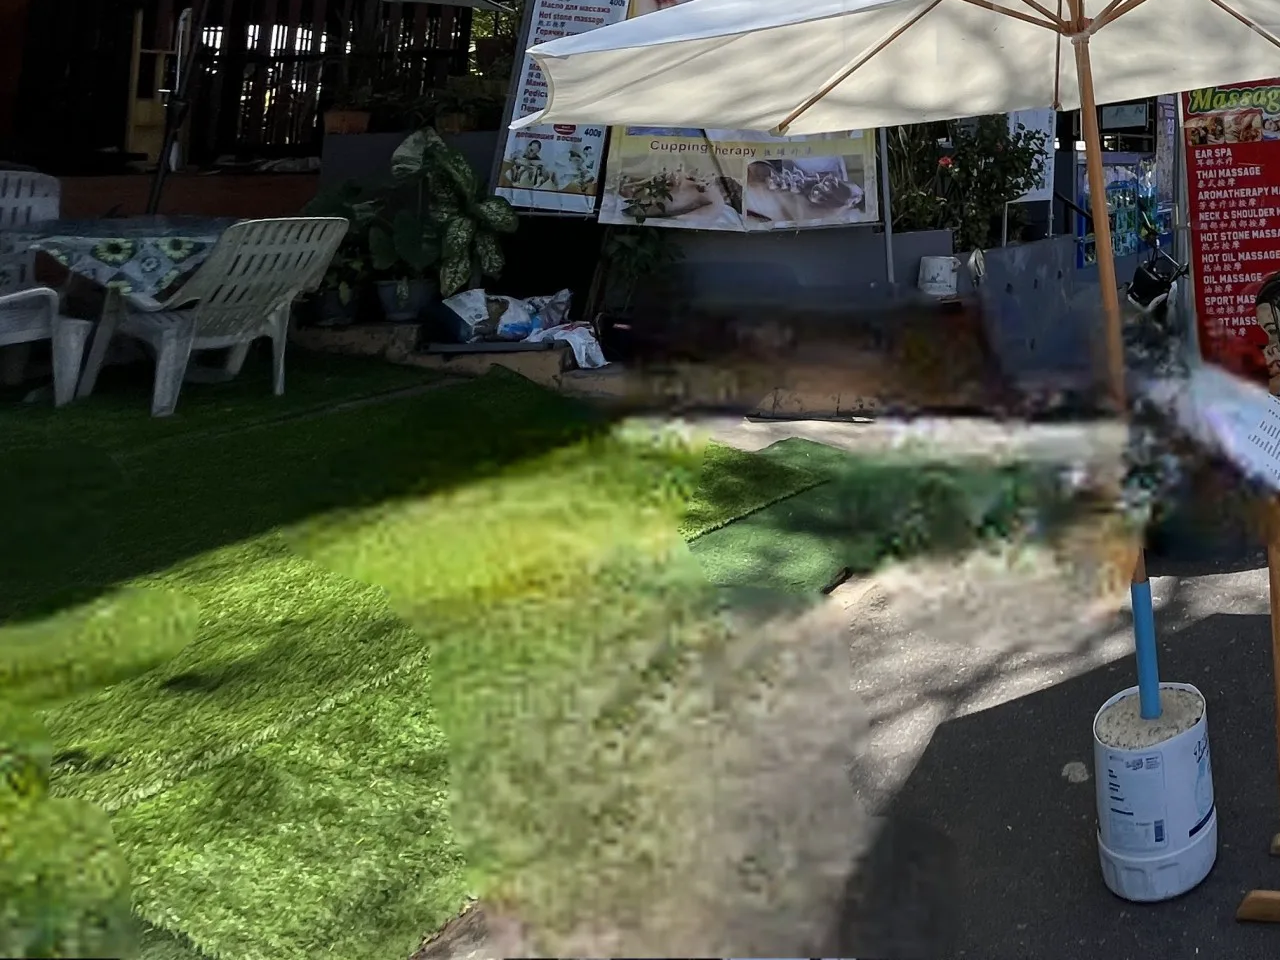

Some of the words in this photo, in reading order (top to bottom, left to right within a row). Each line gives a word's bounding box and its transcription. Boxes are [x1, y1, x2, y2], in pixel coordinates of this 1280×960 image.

[539, 11, 551, 19] Hot
[553, 13, 572, 21] stone
[574, 17, 604, 25] massage
[650, 140, 707, 154] Cupping
[1195, 149, 1213, 159] EAR
[1214, 148, 1232, 157] SPA
[1196, 169, 1217, 179] THAI
[1218, 167, 1261, 178] MASSAGE
[1198, 187, 1269, 200] AROMATHERAPY
[1199, 211, 1220, 221] NECK
[1223, 210, 1229, 219] &
[1231, 206, 1275, 219] SHOULDER
[1200, 233, 1218, 242] HOT
[1220, 230, 1250, 241] STONE
[1202, 254, 1220, 263] HOT
[1222, 252, 1236, 262] OIL
[1238, 250, 1280, 261] MASSAGE
[1203, 275, 1218, 285] OIL
[1220, 272, 1262, 283] MASSAGE
[1204, 295, 1235, 306] SPORT
[1231, 315, 1260, 326] MASS
